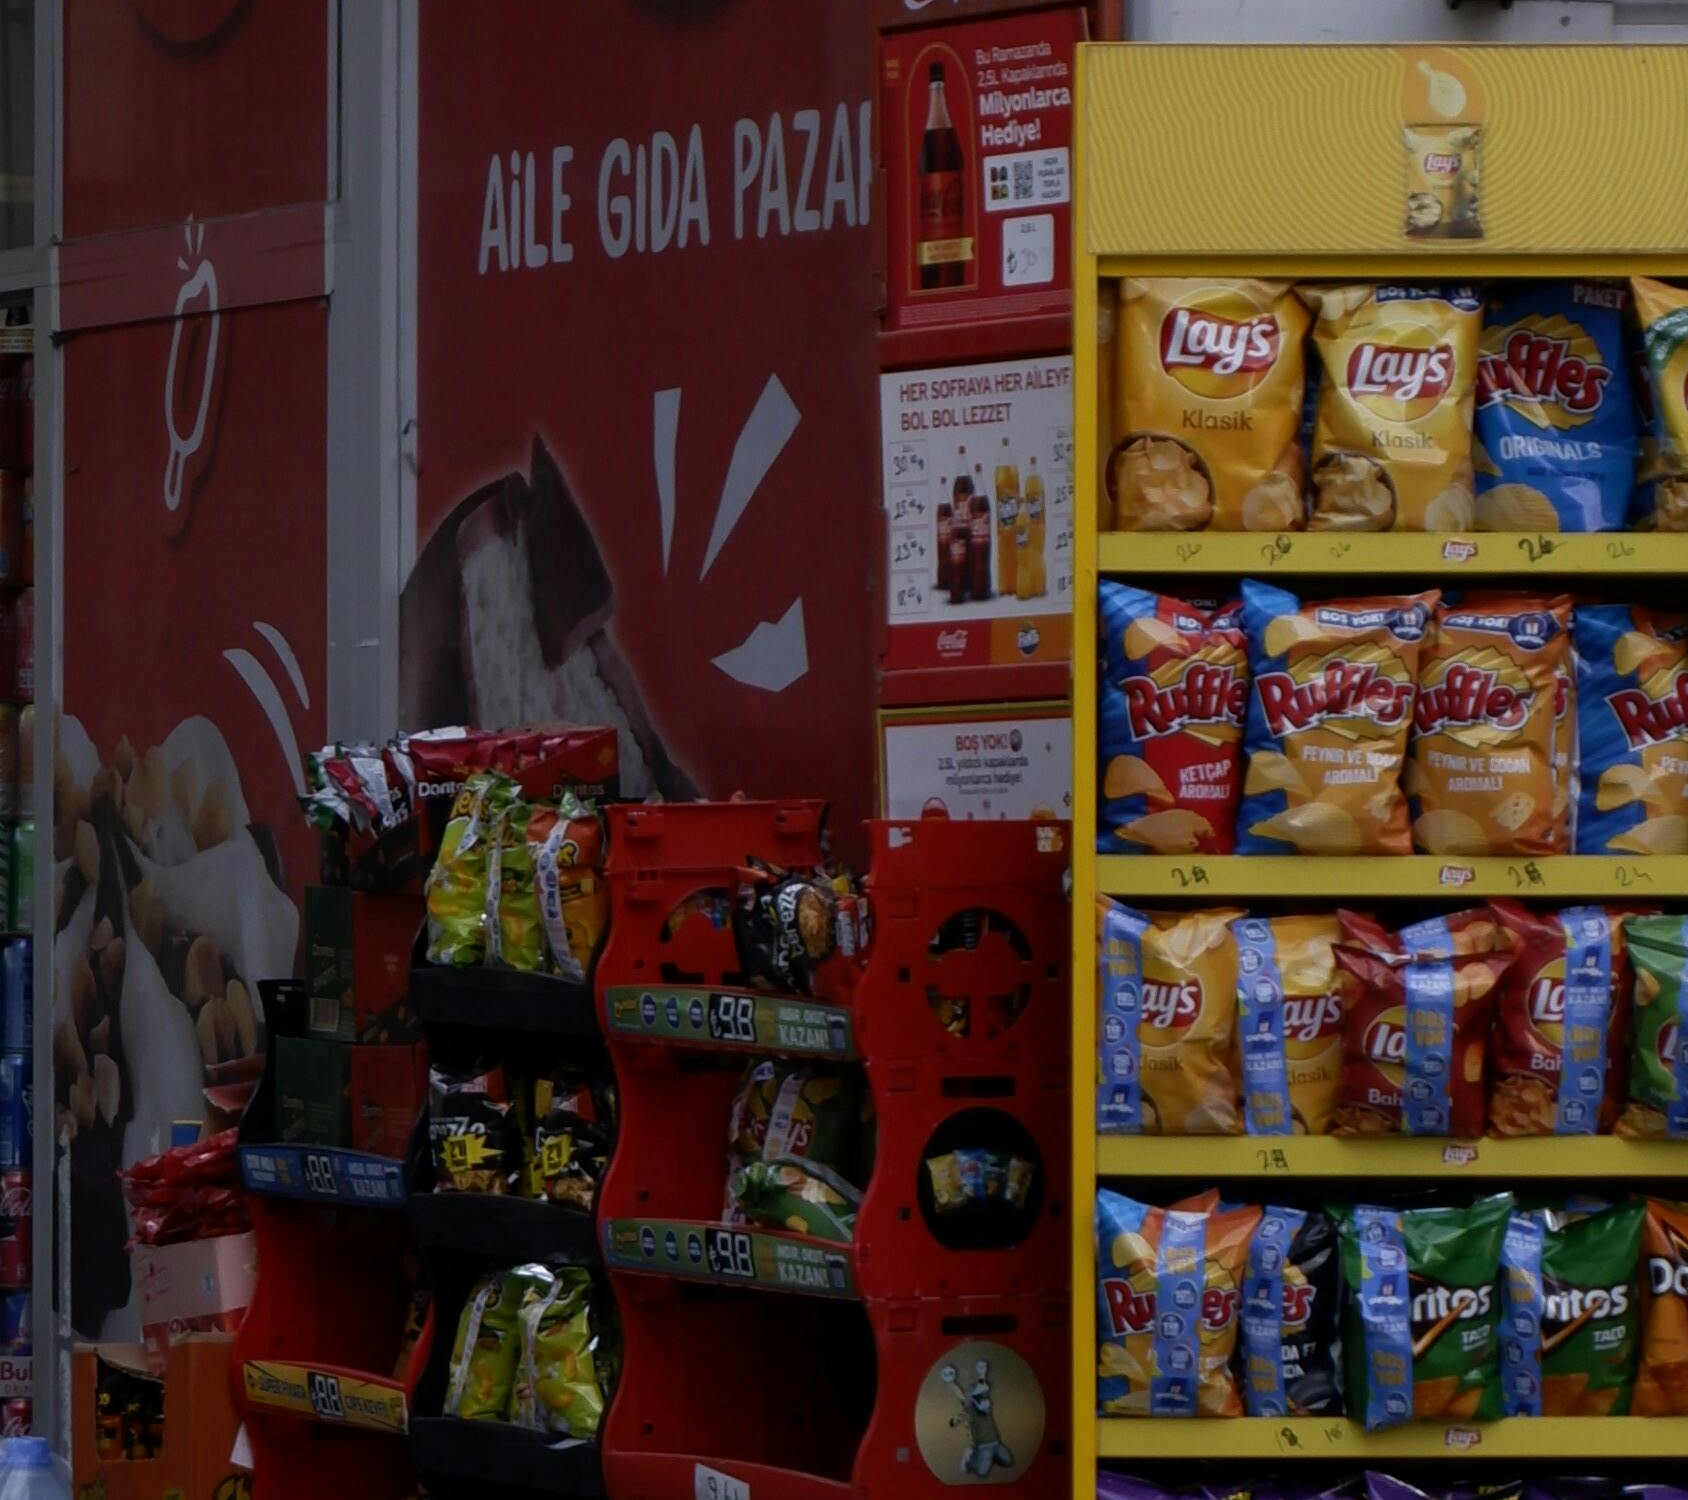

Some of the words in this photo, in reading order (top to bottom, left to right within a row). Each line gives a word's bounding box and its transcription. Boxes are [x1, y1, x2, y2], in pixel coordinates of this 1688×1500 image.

[980, 86, 1071, 118] Milyonlarca
[982, 117, 1041, 148] Hediye!
[1164, 308, 1277, 374] Lay's
[1351, 343, 1452, 401] Lay's
[900, 383, 928, 402] HER
[931, 376, 992, 399] SOFRAYA
[995, 373, 1022, 392] HER
[902, 412, 928, 430] BOL
[932, 409, 958, 428] BOL
[963, 402, 1012, 425] LEZZET
[1181, 409, 1253, 432] Klasik
[1371, 429, 1434, 450] Klasik
[1256, 659, 1416, 738] Ruffles
[1179, 760, 1231, 783] KETÇAP
[1411, 1283, 1496, 1322] ritos
[1460, 1326, 1492, 1346] TACO
[1593, 1327, 1627, 1345] TACO
